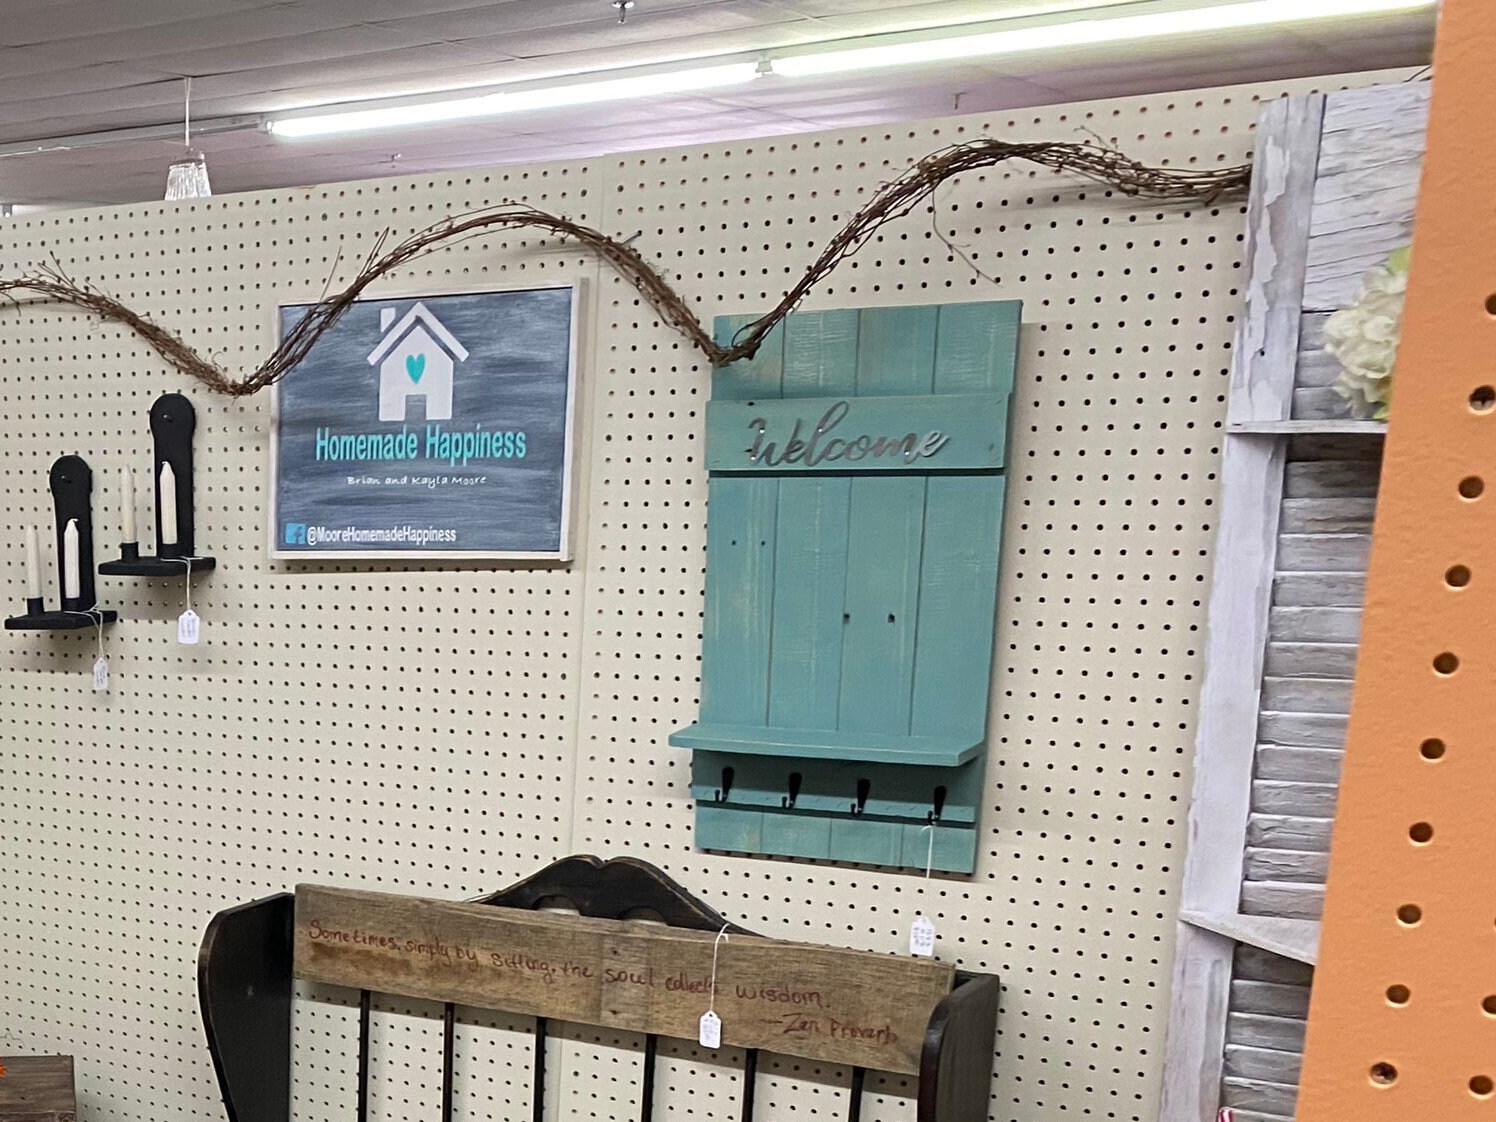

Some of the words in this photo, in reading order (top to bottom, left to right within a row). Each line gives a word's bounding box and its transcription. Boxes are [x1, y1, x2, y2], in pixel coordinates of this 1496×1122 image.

[316, 425, 417, 461] Homemade
[425, 423, 526, 467] Happiness
[748, 401, 950, 467] Welcome
[347, 475, 381, 485] Brian
[385, 475, 408, 485] and
[411, 475, 448, 489] Kayla
[451, 475, 487, 486] Moore
[306, 525, 457, 546] @MooreHomemadeHappiness
[405, 937, 452, 967] simply
[456, 946, 480, 969] by
[560, 961, 594, 978] the
[604, 967, 656, 988] soul
[829, 1017, 899, 1045] Proverb
